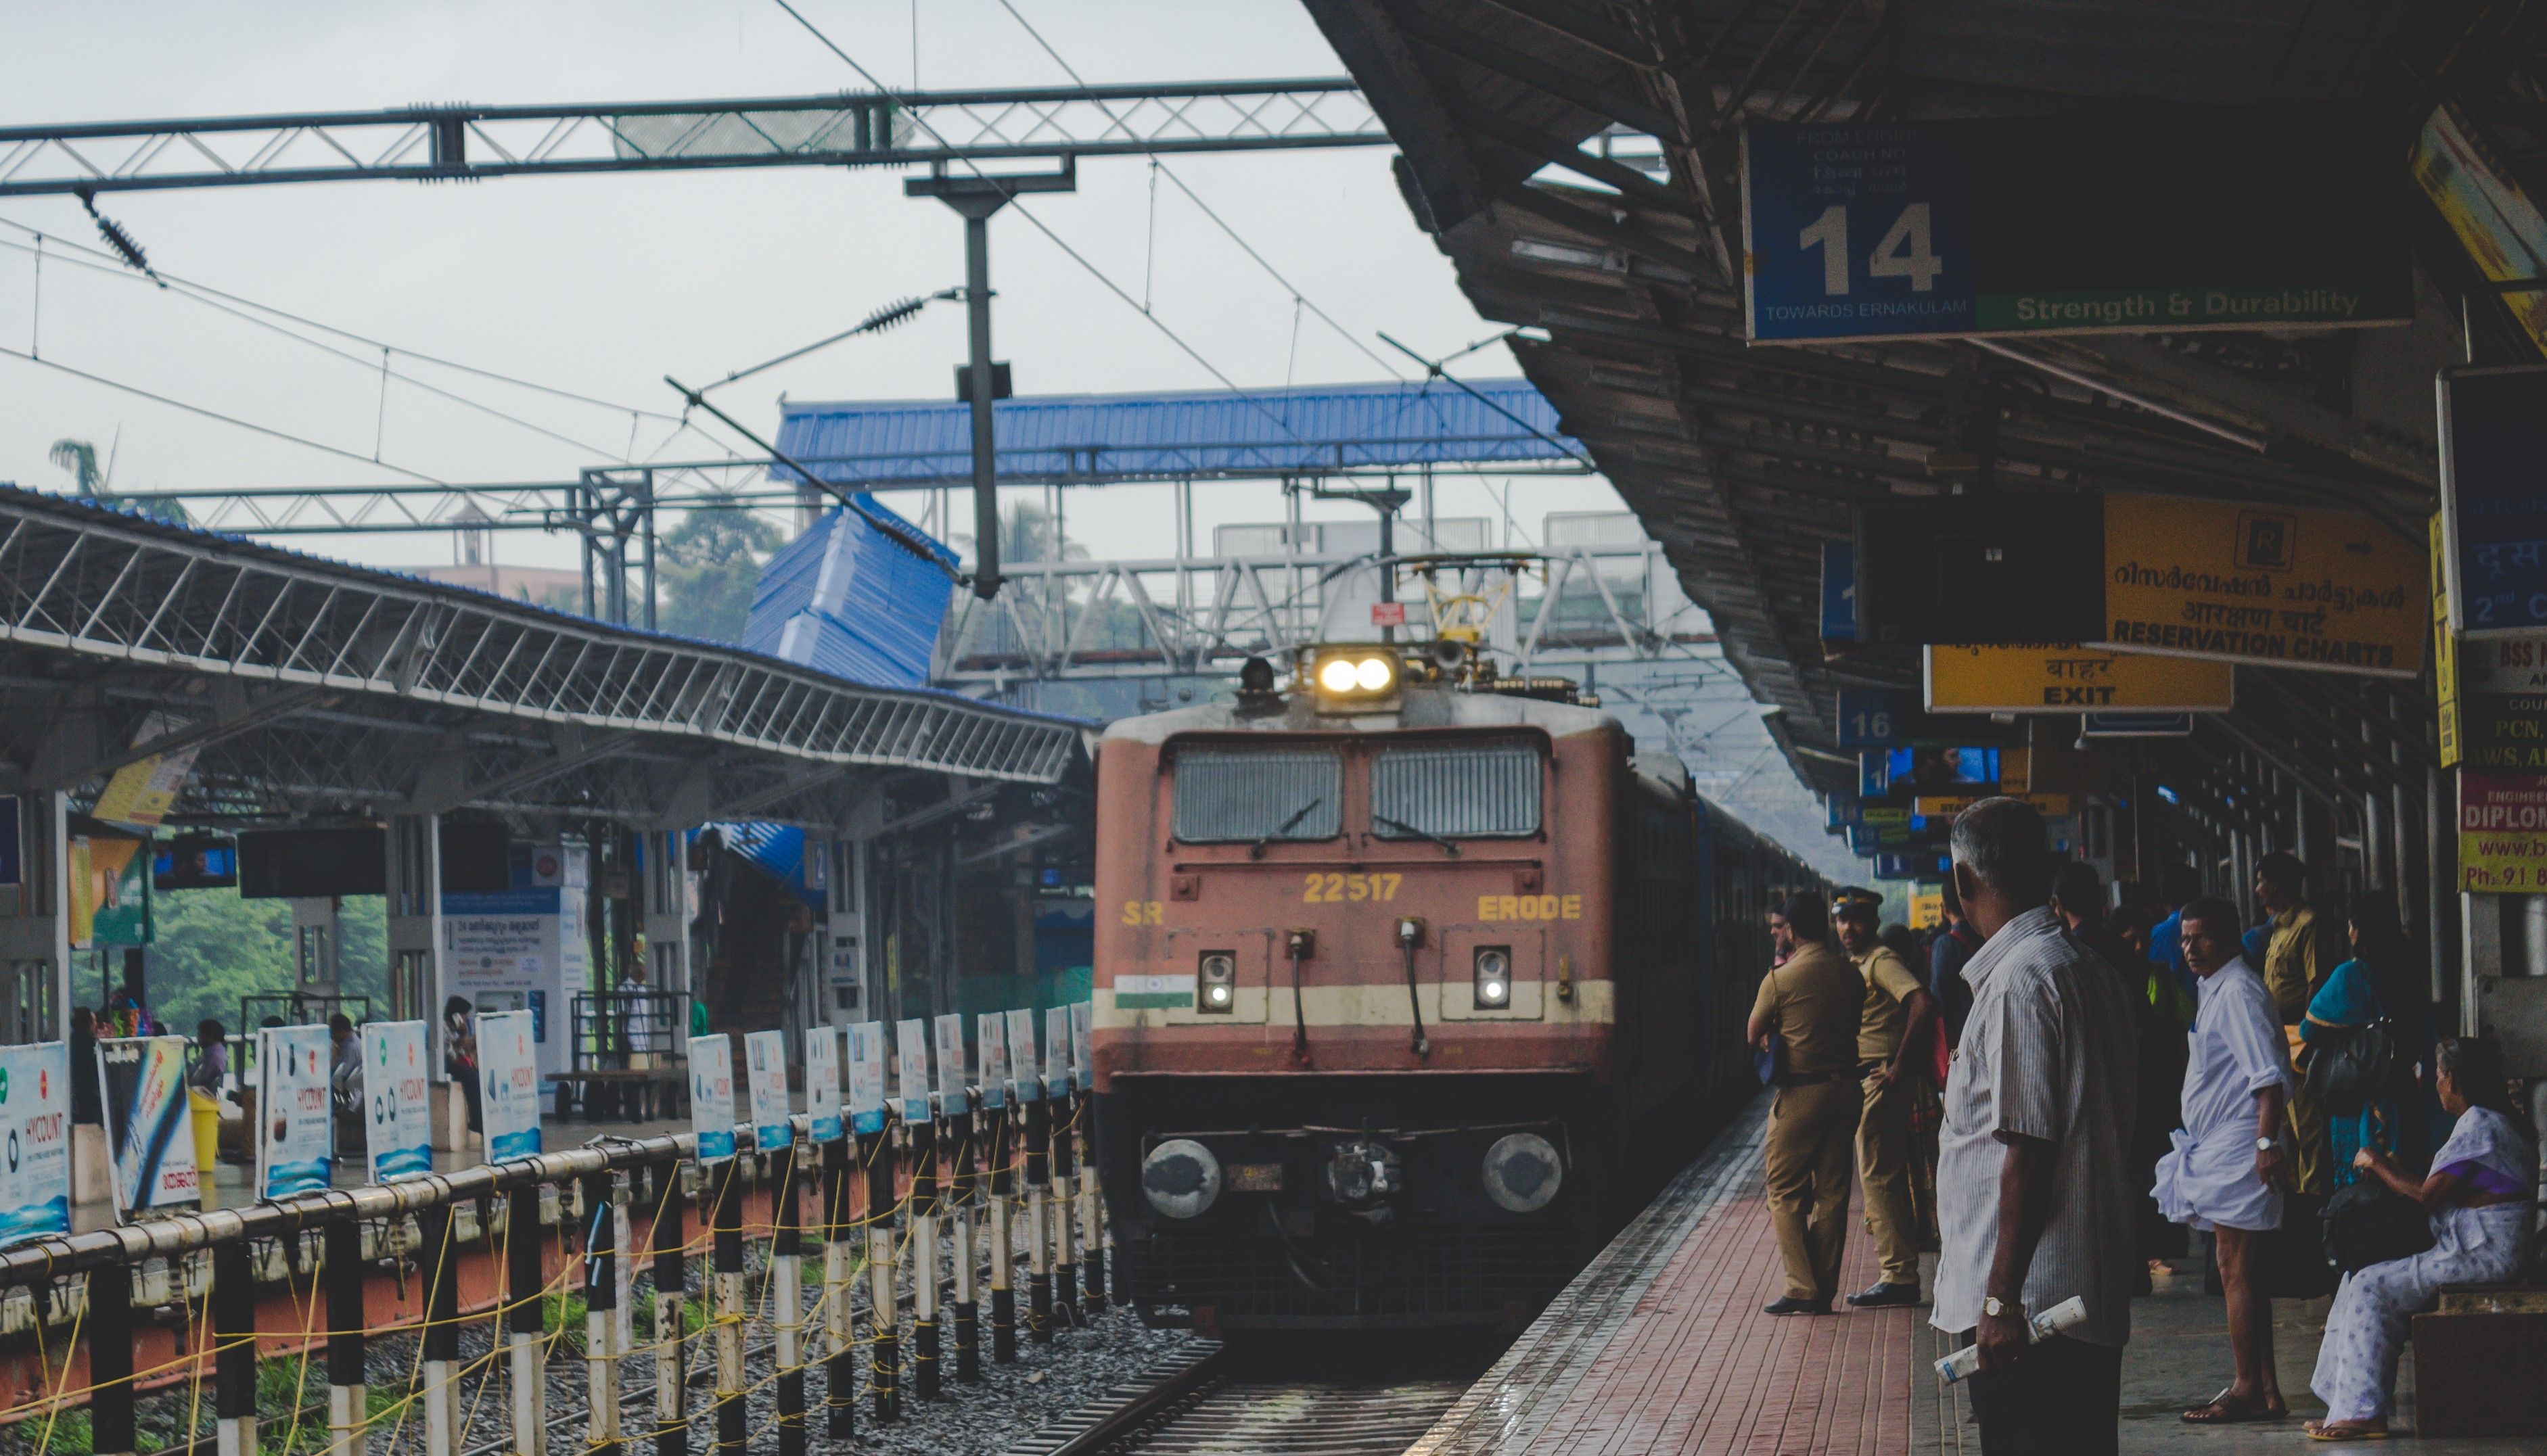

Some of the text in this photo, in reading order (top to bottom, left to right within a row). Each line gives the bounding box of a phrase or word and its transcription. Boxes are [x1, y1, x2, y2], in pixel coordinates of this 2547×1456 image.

[1799, 202, 1943, 296] 14
[1766, 299, 1967, 321] TOWARDS ERNAKULAM
[2017, 289, 2360, 325] Strength & Durability
[2257, 530, 2276, 553] R
[2471, 540, 2547, 582] दूस
[2475, 590, 2517, 623] 2nd
[2114, 619, 2395, 667] RESERVATION CHARTS
[2044, 686, 2115, 705] EXIT
[1852, 711, 1891, 738] 16
[2495, 719, 2544, 741] PCN,
[1302, 872, 1402, 903] 22517
[2503, 866, 2526, 887] 91
[1121, 901, 1164, 926] SR
[1477, 894, 1583, 921] ERODE
[26, 1112, 62, 1146] HYCOUNT
